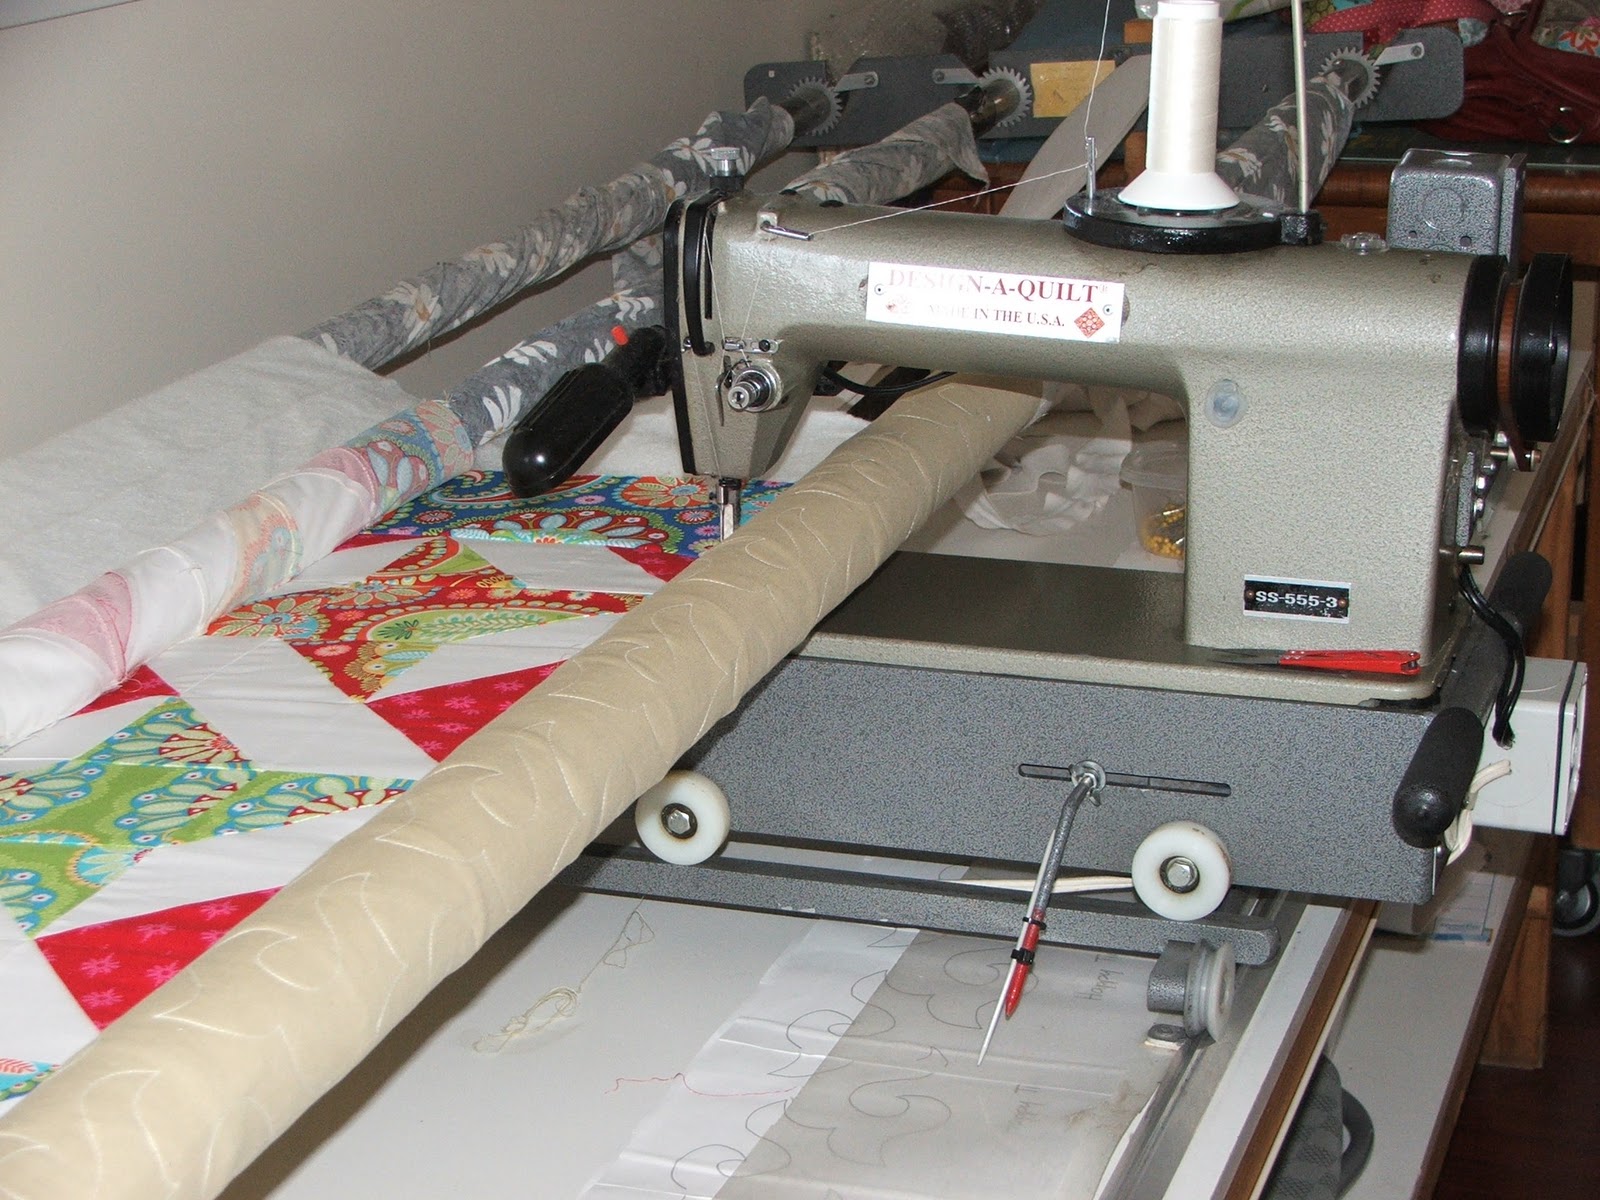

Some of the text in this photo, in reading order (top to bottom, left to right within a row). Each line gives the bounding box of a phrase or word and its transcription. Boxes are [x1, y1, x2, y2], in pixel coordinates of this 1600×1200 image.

[974, 308, 989, 320] IN
[994, 309, 1022, 324] THE
[1027, 312, 1065, 327] U.S.A.
[1255, 590, 1338, 608] SS-555-3
